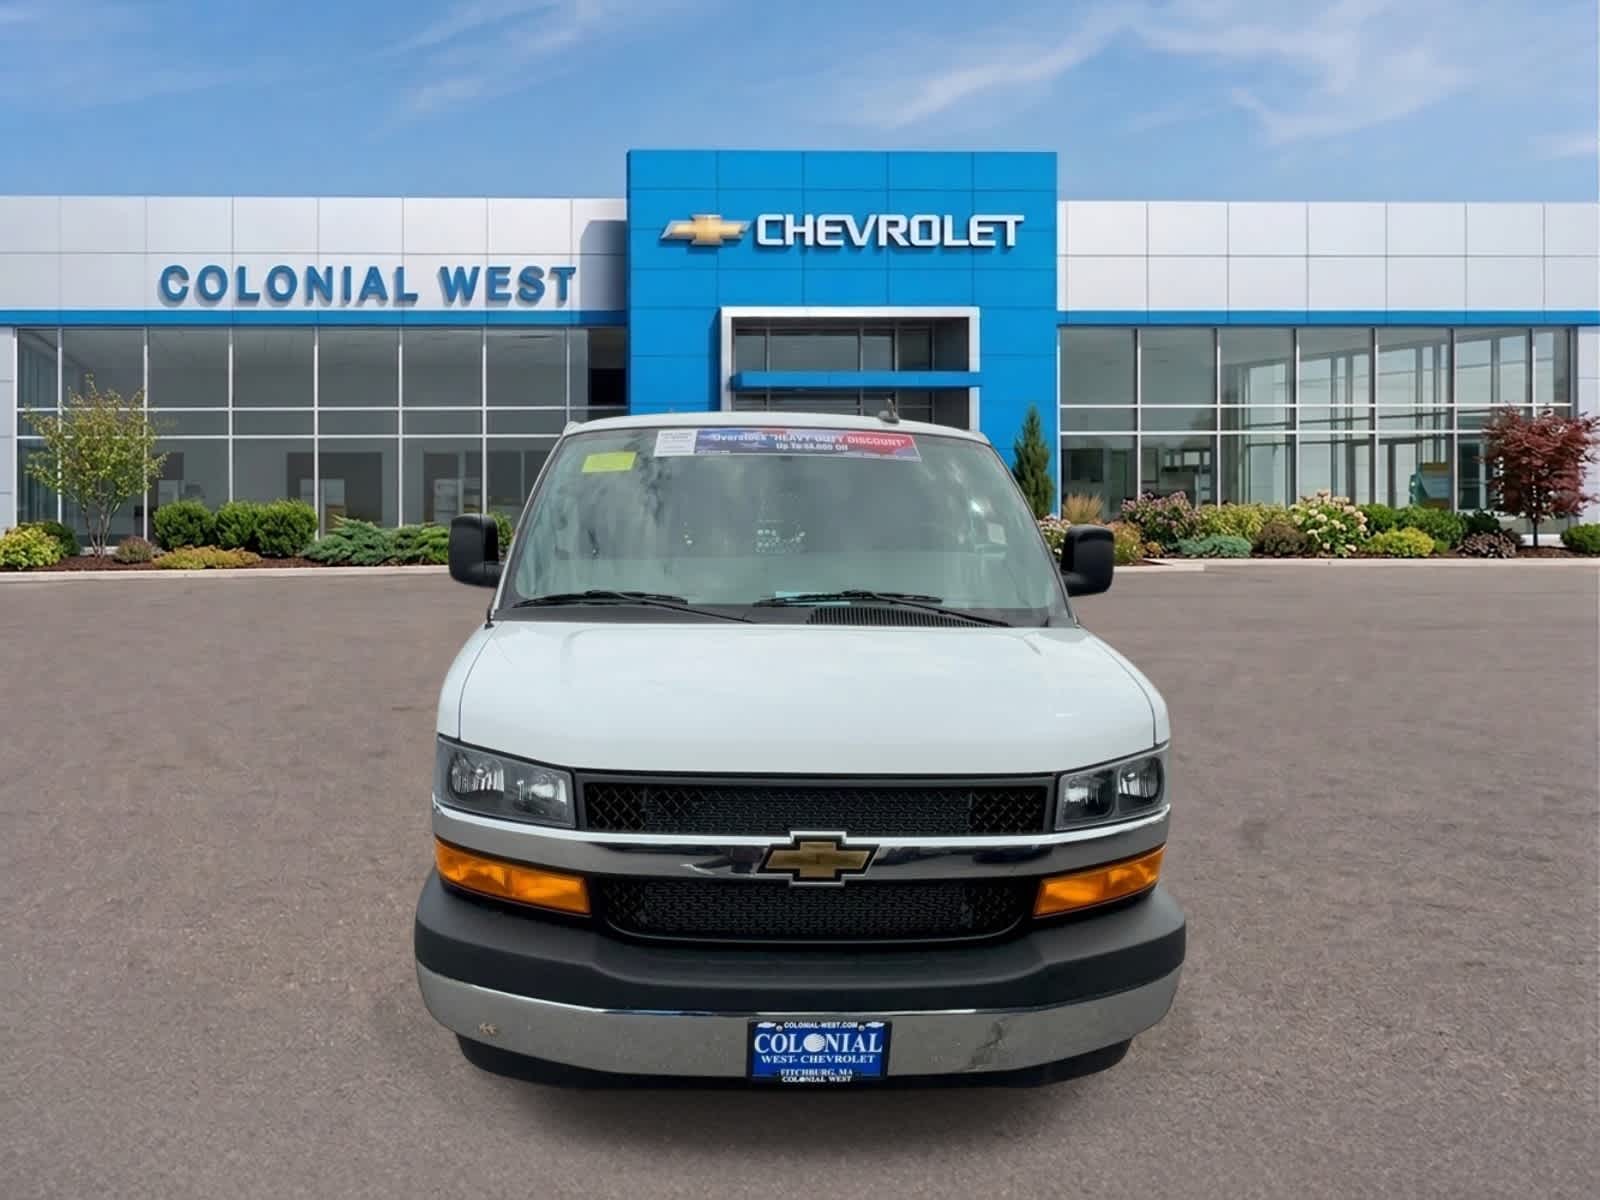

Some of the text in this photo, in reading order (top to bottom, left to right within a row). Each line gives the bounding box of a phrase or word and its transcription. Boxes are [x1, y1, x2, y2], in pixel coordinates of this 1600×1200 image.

[757, 214, 1024, 247] CHEVROLET
[160, 265, 576, 305] COLONIAL WEST
[783, 1021, 858, 1029] COLONIAL-WEST.COM
[754, 1032, 883, 1053] COLONIAL
[800, 1055, 876, 1063] CHEVROLET
[838, 1068, 853, 1076] MA
[781, 1075, 851, 1083] COLONIAL WEST
